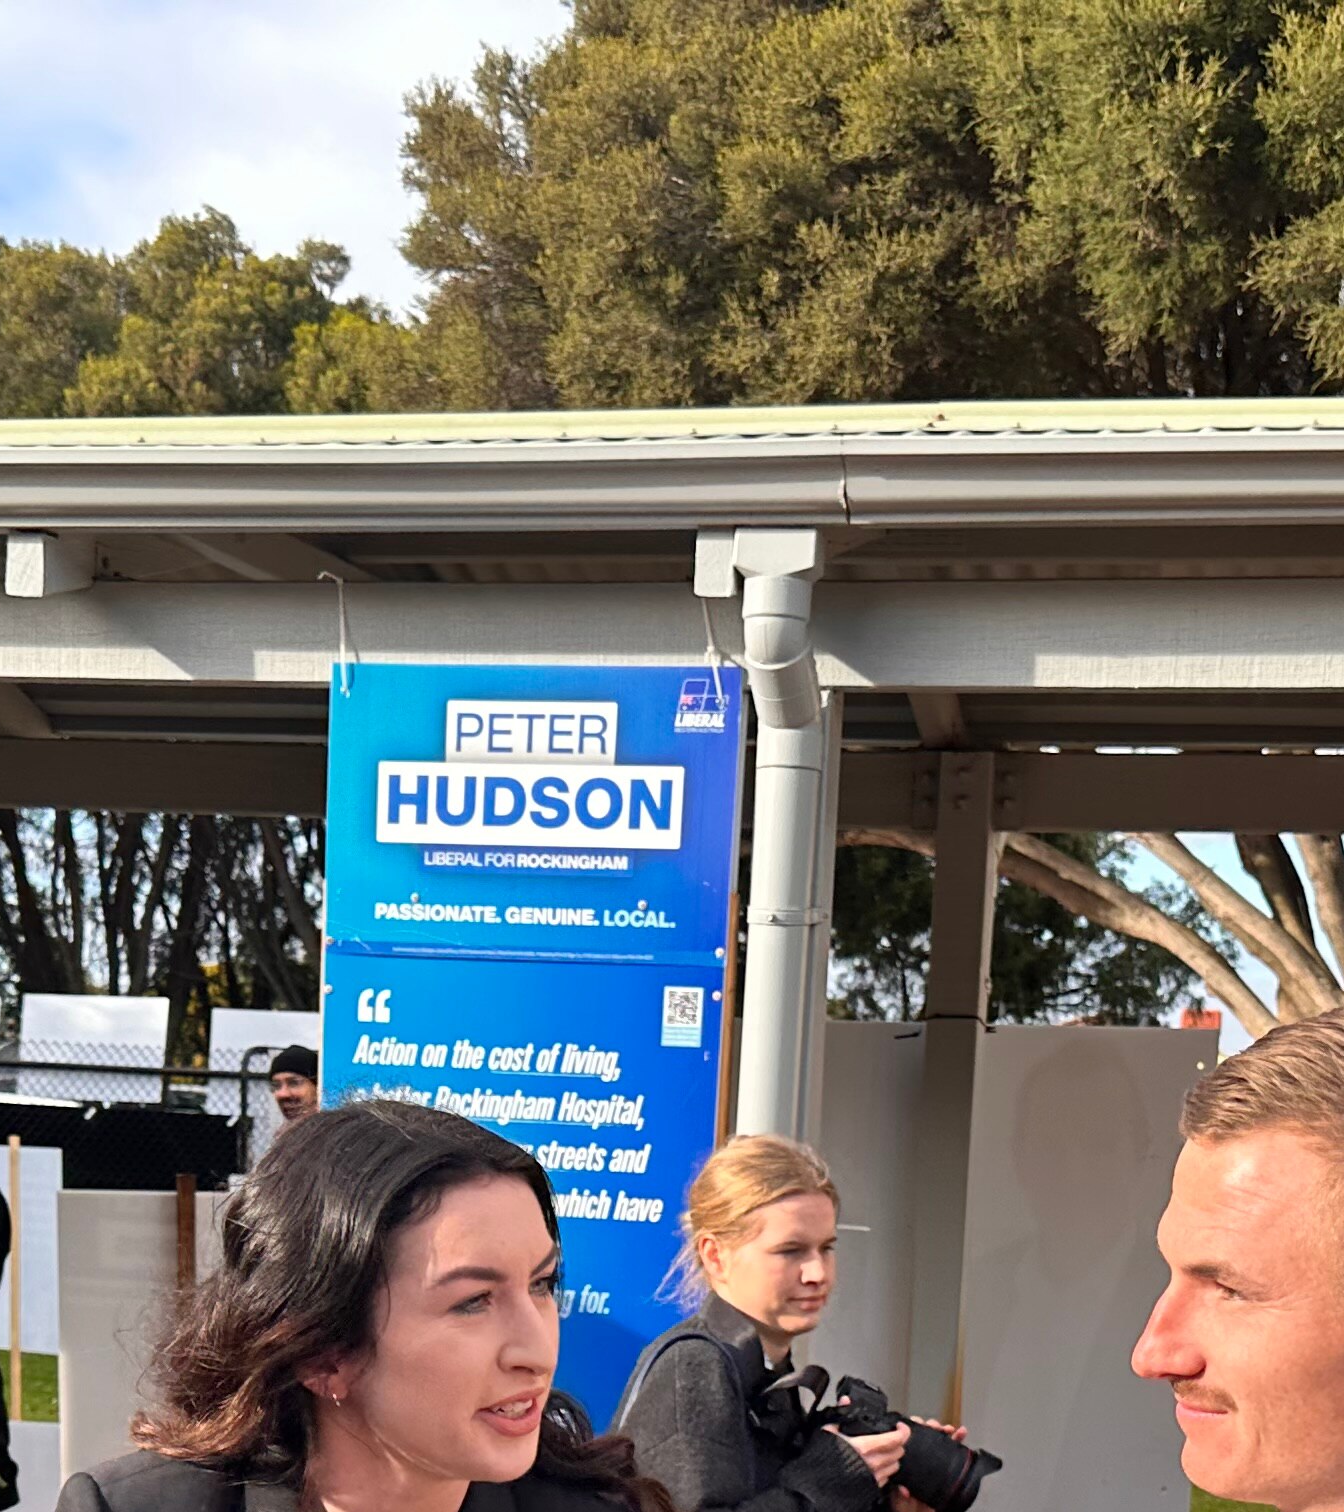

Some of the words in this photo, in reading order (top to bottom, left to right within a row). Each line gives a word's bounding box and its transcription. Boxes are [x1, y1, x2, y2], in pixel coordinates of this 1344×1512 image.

[455, 712, 608, 755] PETER
[674, 713, 725, 728] LIBERAL
[387, 774, 673, 830] HUDSON
[424, 851, 483, 868] LIBERAL
[484, 852, 517, 868] FOR
[517, 853, 629, 871] ROCKINGHAM
[374, 902, 502, 924] PASSIONATE.
[504, 905, 600, 927] GENUINE.
[603, 909, 676, 929] LOCAL.
[352, 1034, 419, 1067] Action
[421, 1044, 448, 1068] on
[451, 1039, 485, 1070] the
[488, 1042, 534, 1073] cost
[535, 1043, 561, 1074] of
[560, 1043, 621, 1082] living,
[434, 1086, 557, 1126] Rockingham
[558, 1091, 645, 1131] Hospital,
[537, 1140, 608, 1172] streets
[608, 1143, 652, 1174] and
[554, 1187, 612, 1220] which
[613, 1190, 664, 1223] have
[578, 1284, 610, 1315] for.
